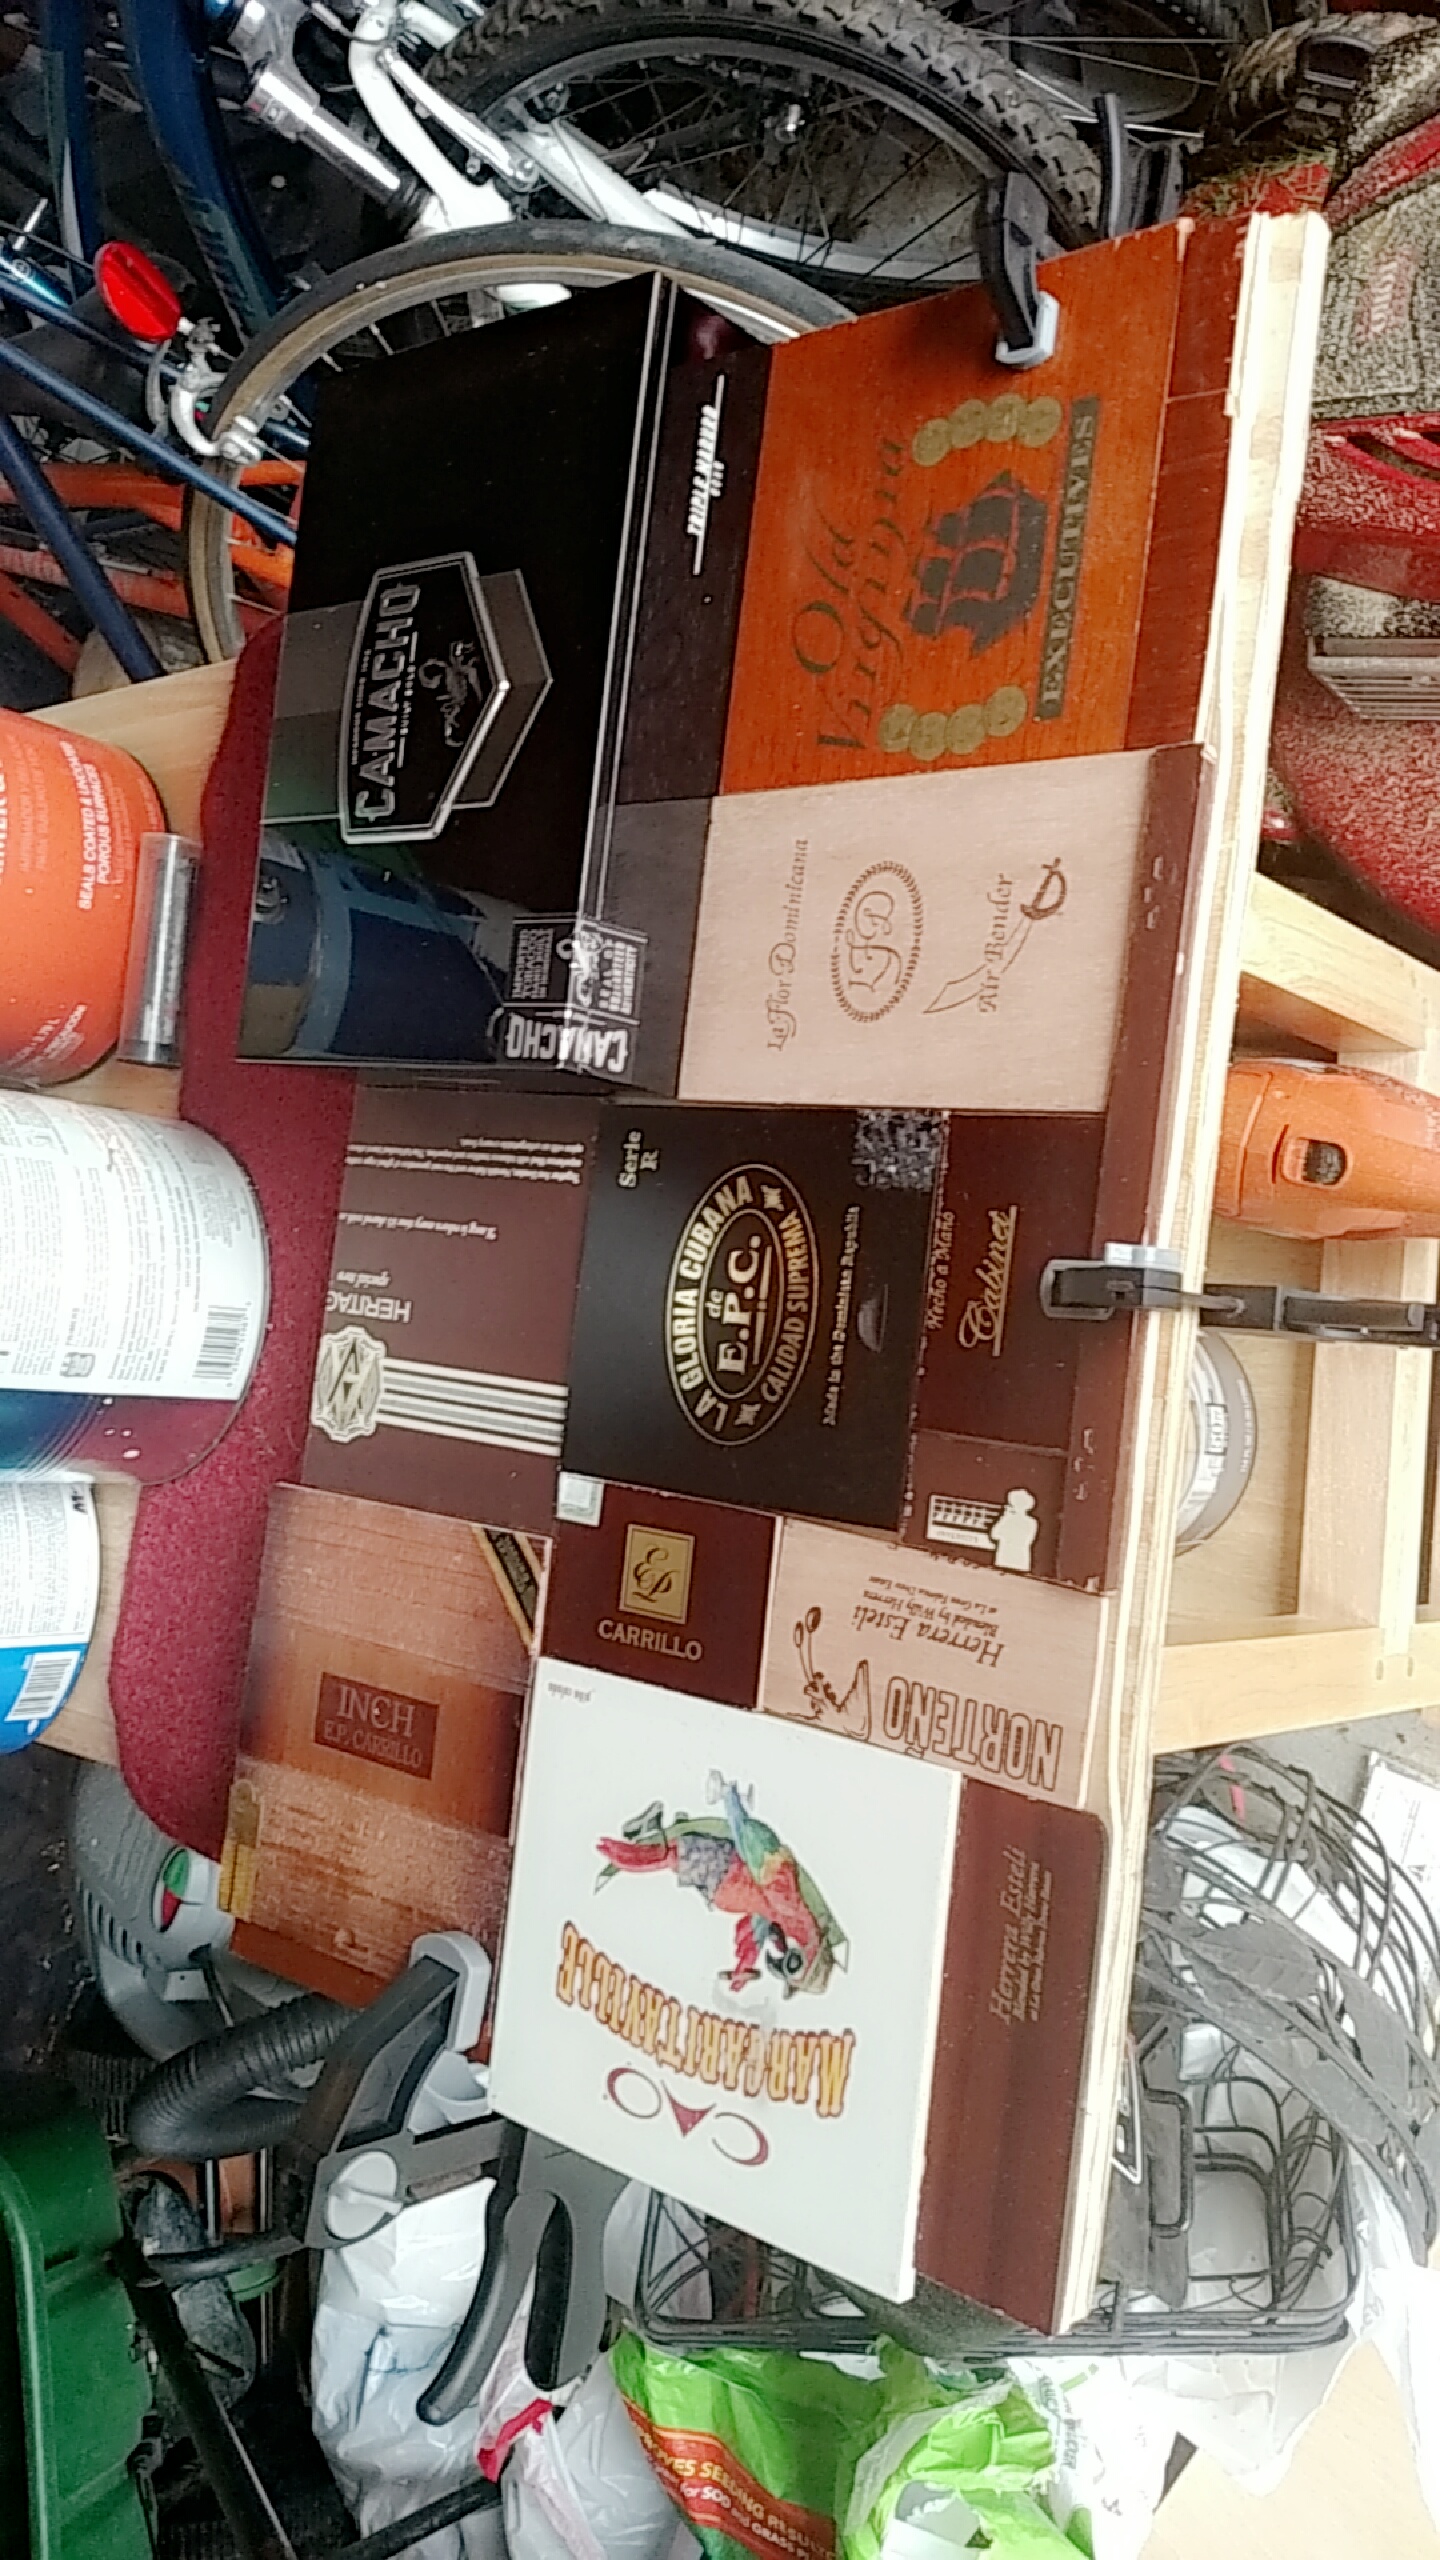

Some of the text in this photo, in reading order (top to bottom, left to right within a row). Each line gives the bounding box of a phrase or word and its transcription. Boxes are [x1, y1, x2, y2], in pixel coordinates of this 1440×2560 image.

[1043, 414, 1093, 704] EXECUTIVES
[791, 437, 905, 748] Old Virginia
[354, 583, 421, 823] CAMACHO
[79, 807, 97, 862] COATED
[95, 823, 112, 885] POROUS
[76, 863, 97, 911] SEALS
[768, 839, 809, 977] Dominicana
[978, 968, 1001, 1013] Air
[505, 1013, 629, 1073] CAMACHO
[617, 1130, 643, 1189] Serie
[640, 1148, 660, 1172] R
[672, 1174, 754, 1432] LA GLORIA CUBANA
[704, 1288, 725, 1319] de
[716, 1234, 762, 1374] E.P.C.
[761, 1209, 811, 1403] CALIDAD SUPREMA
[957, 1209, 1010, 1348] Cabinet
[597, 1618, 704, 1662] CARRILLO
[916, 1622, 1006, 1669] Herrera
[938, 1607, 953, 1624] by
[336, 1684, 416, 1738] INCH
[883, 1675, 1064, 1792] NORTEÑO
[556, 1920, 857, 2119] MARGARITAVILLE
[606, 2067, 770, 2166] CAO
